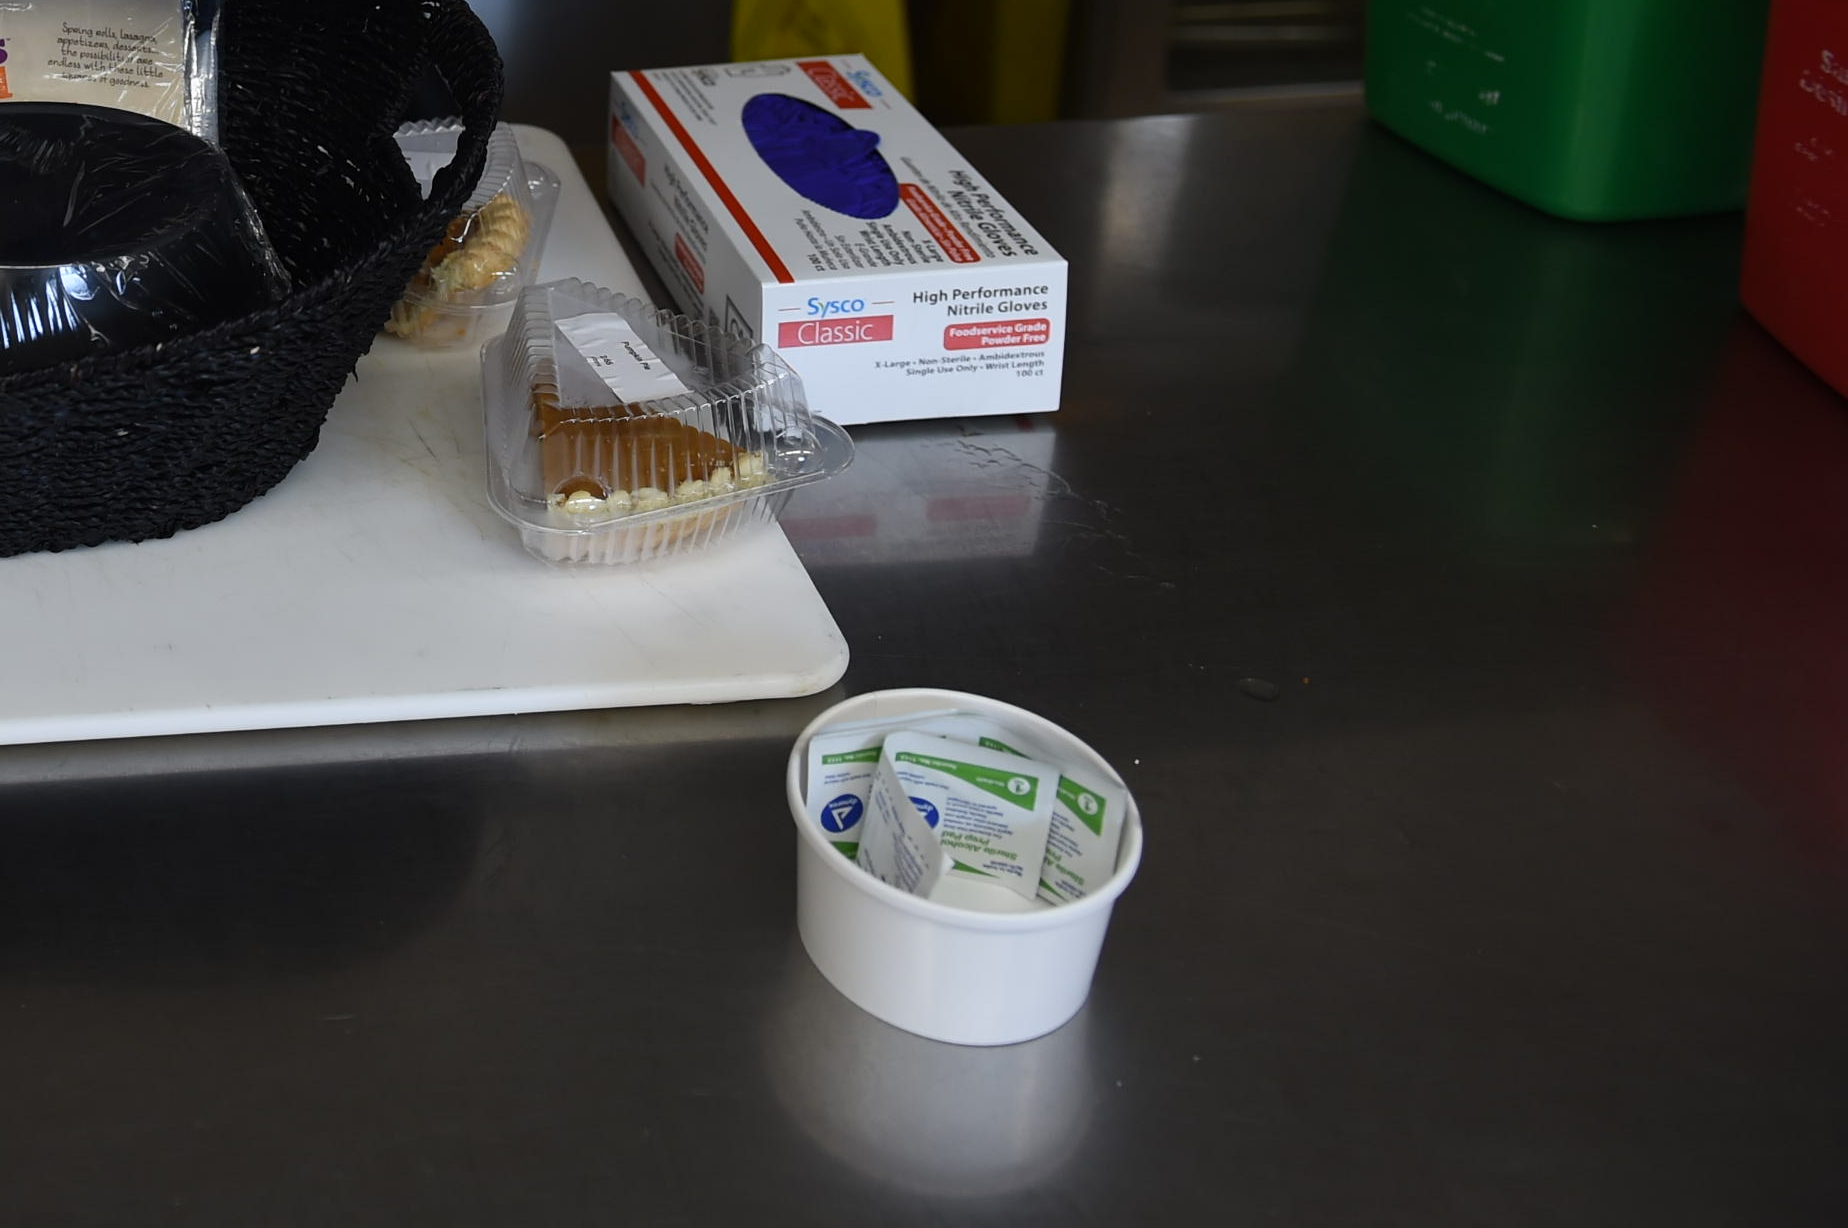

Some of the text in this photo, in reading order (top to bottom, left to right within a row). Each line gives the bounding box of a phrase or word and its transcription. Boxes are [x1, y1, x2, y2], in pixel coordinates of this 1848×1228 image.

[61, 21, 94, 37] Spring
[47, 56, 81, 69] endless
[83, 61, 106, 72] with
[136, 64, 163, 78] little
[950, 170, 1037, 254] High Performance
[948, 191, 1016, 256] Nitrile Gloves
[912, 285, 1049, 306] High Performance
[807, 297, 864, 318] Sysco
[947, 301, 1048, 317] Nitrile Gloves
[797, 320, 874, 345] Classic
[949, 322, 1047, 338] Foodservice Grade
[981, 333, 1046, 346] Powder Free
[875, 351, 1045, 369] X-Large Non-Sterile Ambidextrous
[906, 360, 1045, 377] Single Use Only Wrist Length
[1016, 369, 1044, 378] 100 ct
[941, 830, 989, 845] Prep Pad
[940, 839, 1016, 860] Sterile Alcohol
